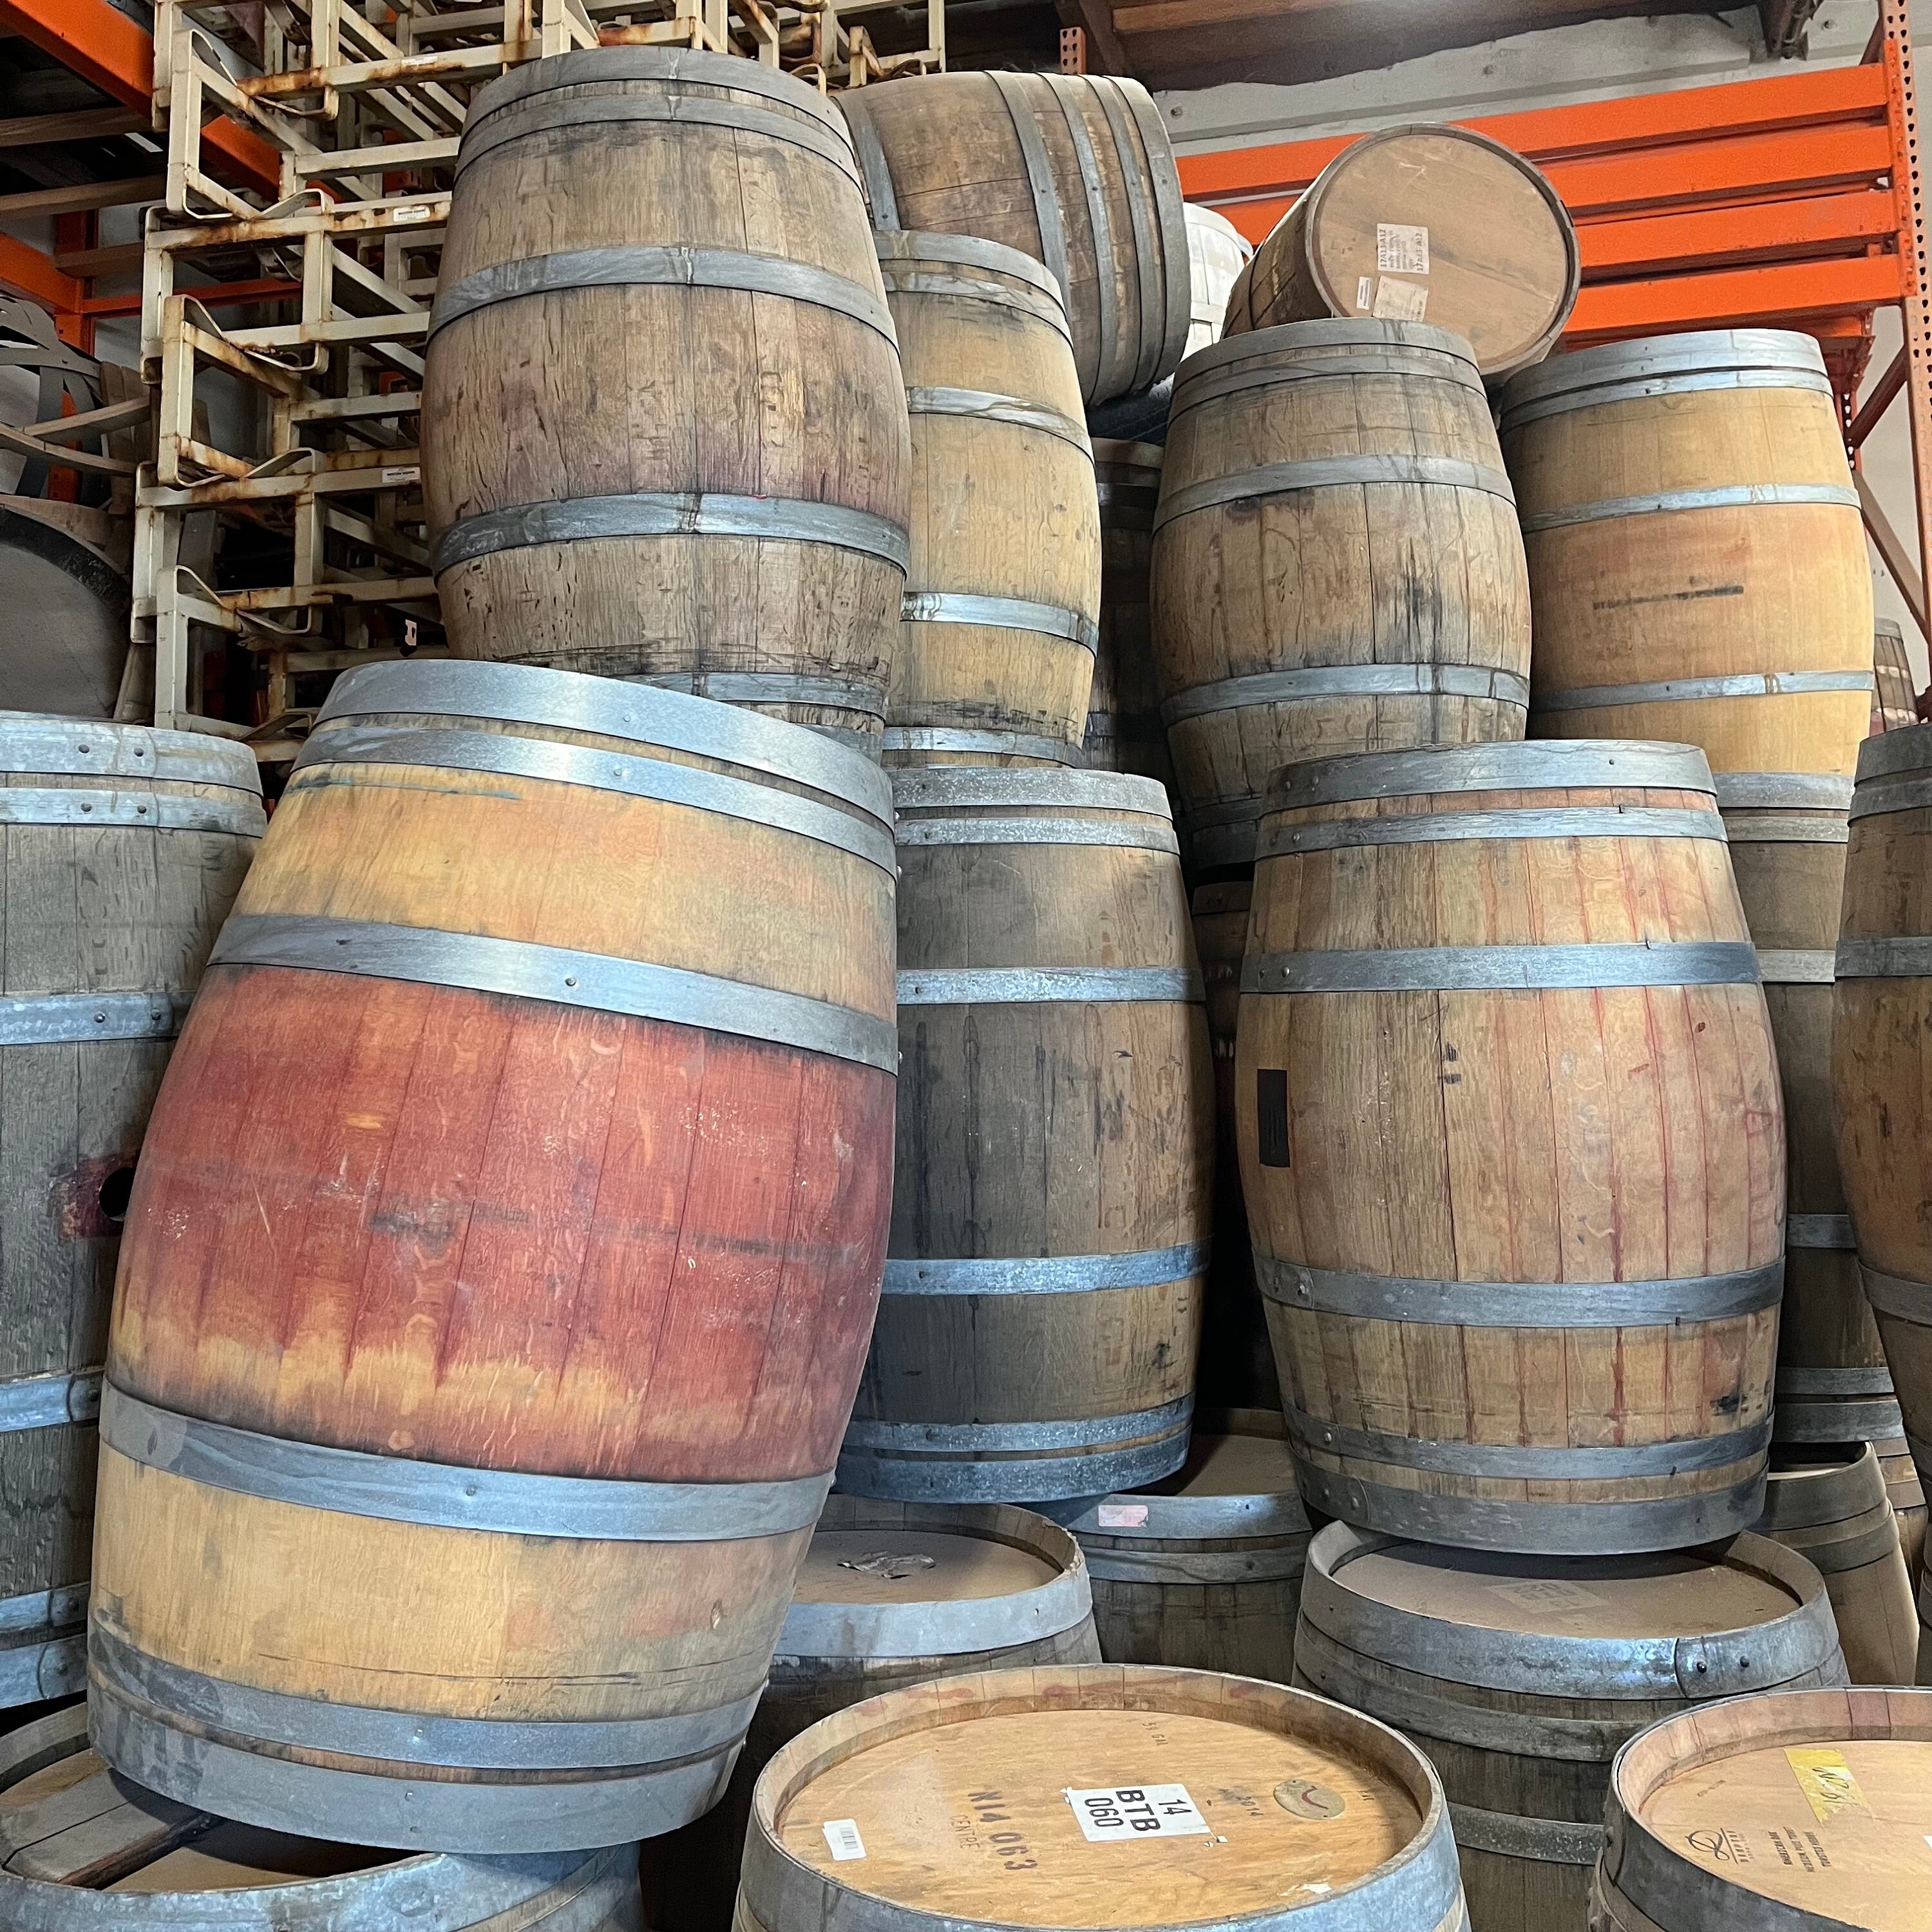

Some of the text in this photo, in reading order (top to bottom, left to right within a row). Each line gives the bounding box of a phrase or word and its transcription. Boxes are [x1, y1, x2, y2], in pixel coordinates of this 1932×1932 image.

[1084, 1797, 1124, 1828] 060
[1115, 1790, 1161, 1832] BTB
[1158, 1799, 1192, 1815] 14
[950, 1814, 981, 1849] CENTRE
[967, 1790, 1038, 1870] N14 063
